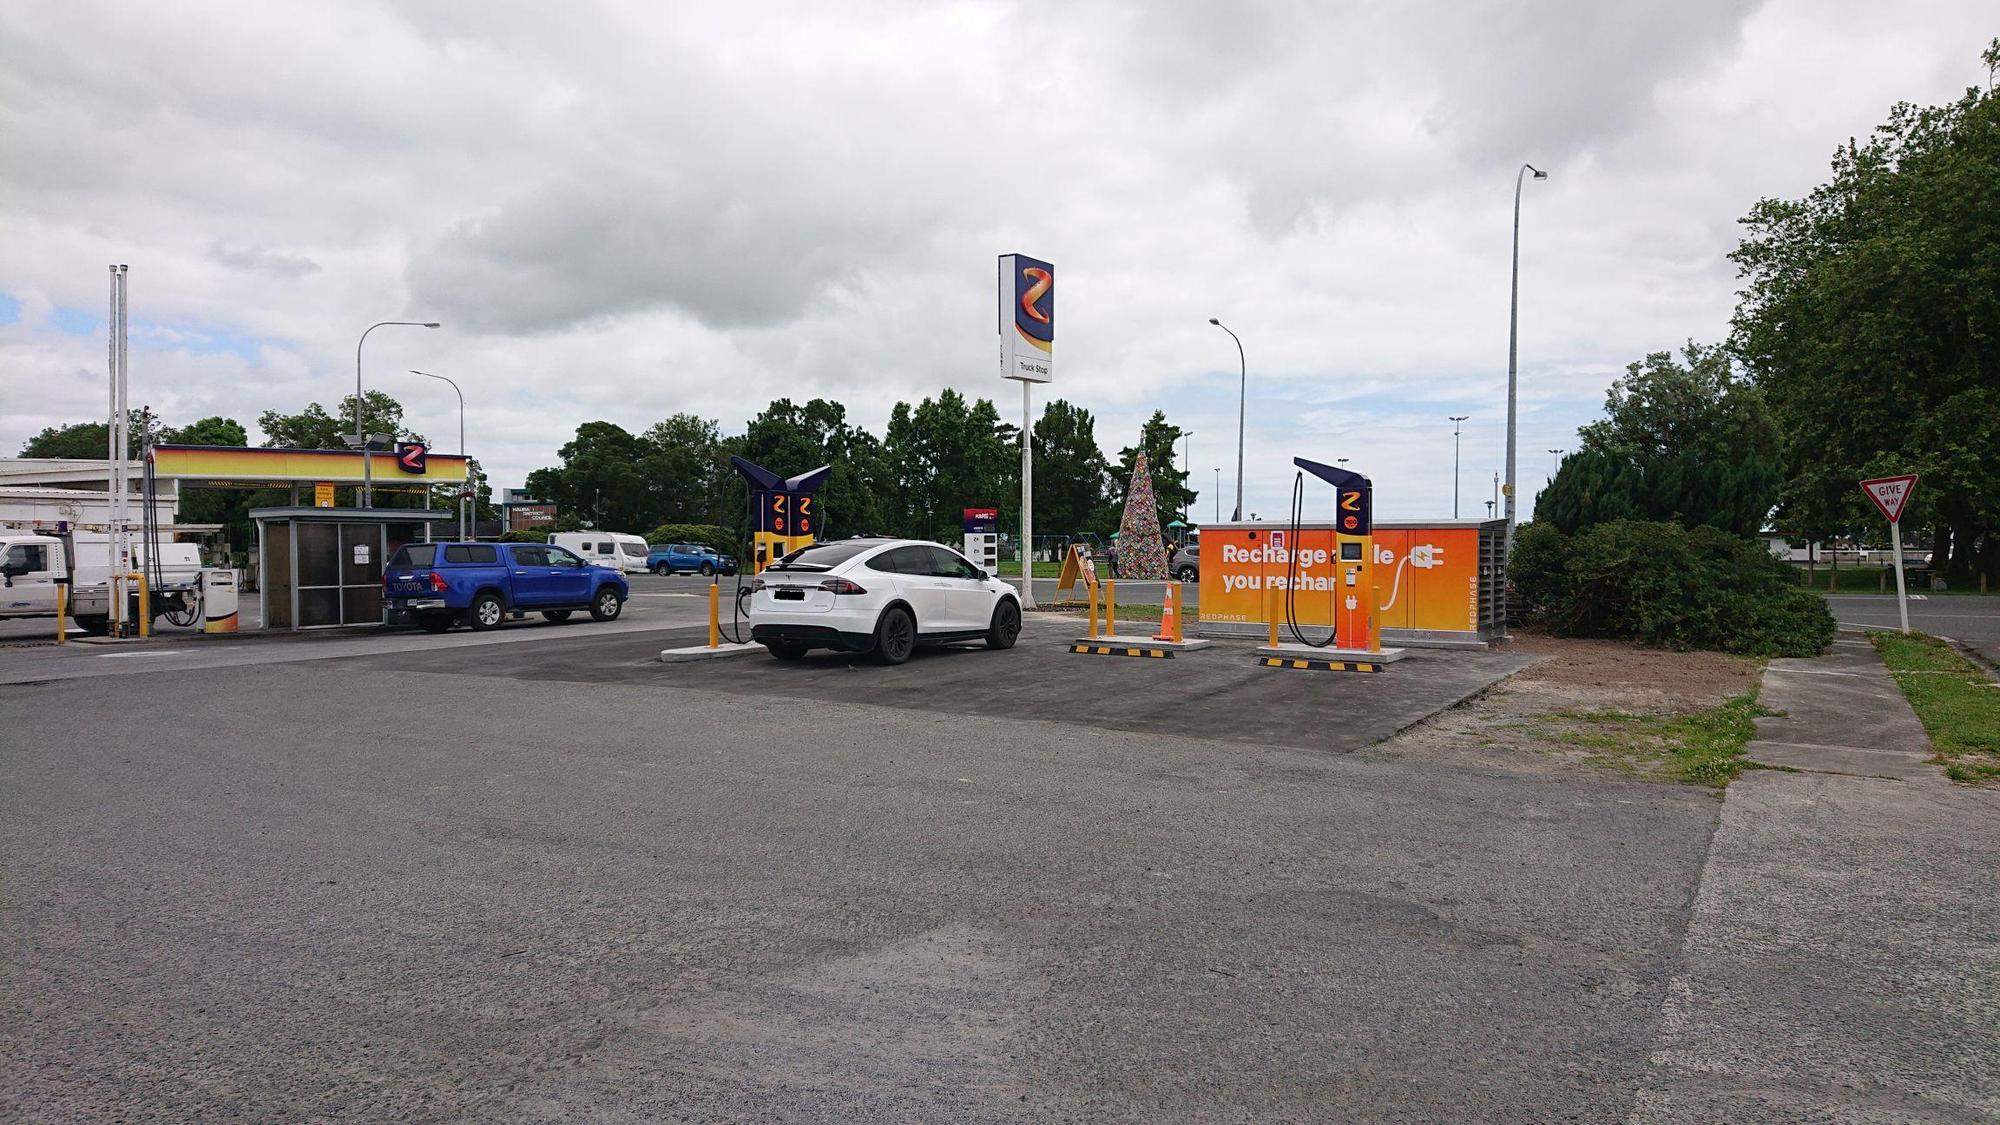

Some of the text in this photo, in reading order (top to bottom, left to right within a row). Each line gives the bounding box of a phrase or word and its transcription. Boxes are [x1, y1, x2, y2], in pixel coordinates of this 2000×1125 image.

[1020, 361, 1049, 375] Truck Stop
[1878, 484, 1902, 496] GIVE
[1884, 497, 1900, 506] WAY
[1223, 544, 1327, 568] Recharge
[392, 582, 422, 592] TOYOTA
[1223, 574, 1261, 593] you
[1265, 571, 1336, 590] rechar
[1470, 575, 1478, 631] REDPHASE
[1200, 612, 1248, 621] REDPHASE
